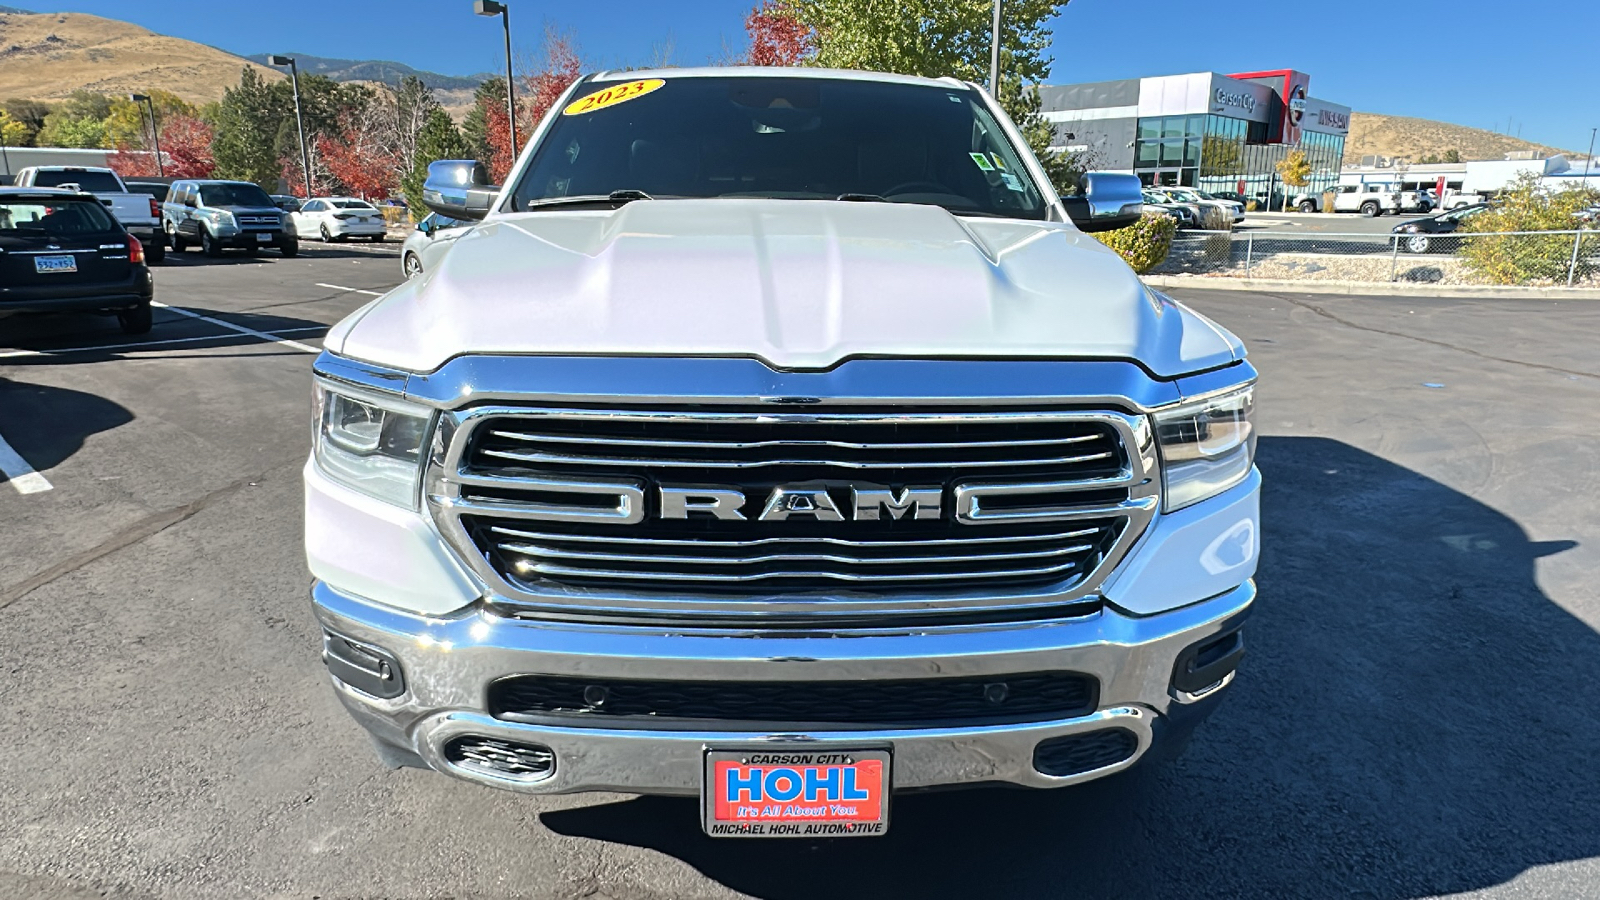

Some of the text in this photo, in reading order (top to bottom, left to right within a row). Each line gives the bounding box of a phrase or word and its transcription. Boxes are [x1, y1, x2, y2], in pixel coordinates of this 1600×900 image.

[579, 82, 645, 111] 2023
[1216, 88, 1257, 114] Carson City
[1319, 109, 1349, 129] NISSAN
[659, 487, 943, 521] RAM
[751, 754, 849, 764] CARSON CITY
[726, 767, 869, 802] HOHL
[737, 806, 758, 818] It's
[760, 805, 780, 817] All
[782, 805, 827, 816] About
[711, 822, 883, 834] MICHAEL HOHL AUTOMOTIVE
